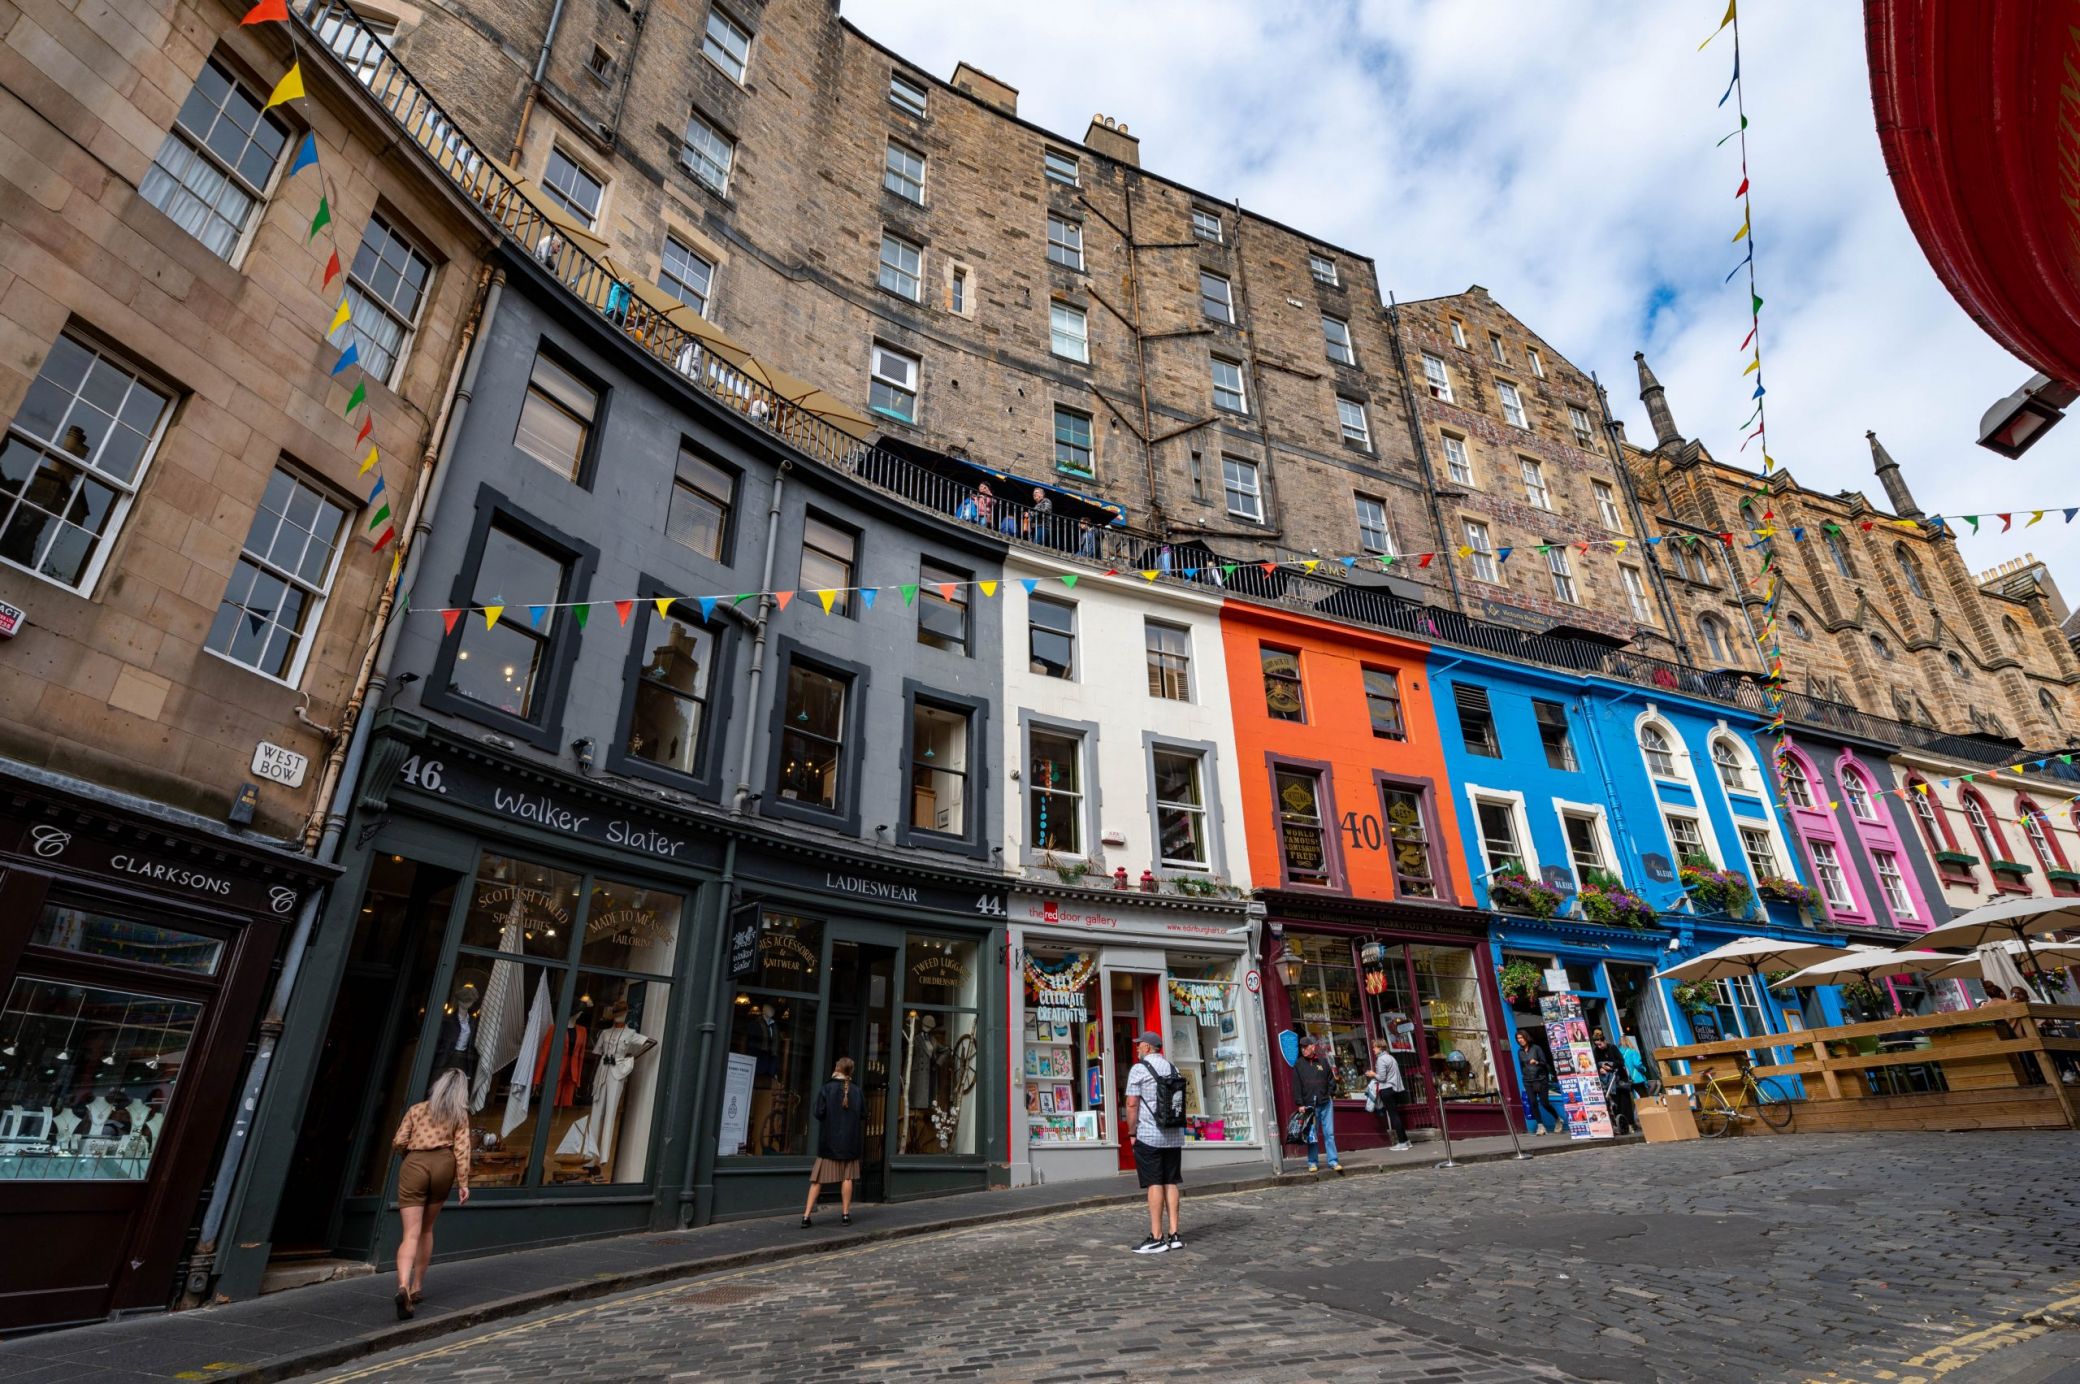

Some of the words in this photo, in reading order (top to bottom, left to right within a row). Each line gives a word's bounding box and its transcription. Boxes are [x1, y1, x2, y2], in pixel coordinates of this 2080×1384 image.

[1502, 609, 1524, 619] Victoria
[1525, 614, 1544, 625] Regalia
[264, 745, 304, 769] WEST
[260, 760, 296, 781] BOW
[400, 754, 447, 794] 46.
[494, 788, 590, 832] Walker
[606, 820, 685, 857] Slater
[1284, 836, 1318, 846] FAMOUS!
[1285, 828, 1315, 838] WORLD
[1341, 812, 1381, 851] 40
[1290, 852, 1317, 861] FREE!
[110, 854, 231, 895] CLARKSONS
[1656, 869, 1673, 878] BLEUE
[826, 873, 918, 902] LADIESWEAR
[976, 894, 1006, 916] 44.
[1555, 880, 1574, 890] BLEUE
[478, 887, 535, 908] SCOTTISH
[538, 894, 568, 924] TWEED
[492, 912, 550, 932] SPECLITIES
[590, 913, 616, 934] MADE
[620, 911, 634, 922] TO
[1028, 908, 1044, 918] the
[1044, 910, 1058, 920] red
[1060, 912, 1080, 923] door
[1085, 915, 1117, 928] gallery
[630, 926, 638, 934] &
[774, 936, 818, 967] ACCESSORIES
[763, 958, 800, 970] KNITWEAR
[912, 957, 940, 976] TWEED
[1039, 990, 1085, 1006] CELEBRATE
[1037, 1006, 1088, 1023] CREATIVITY!
[1199, 1012, 1220, 1028] LIFE!
